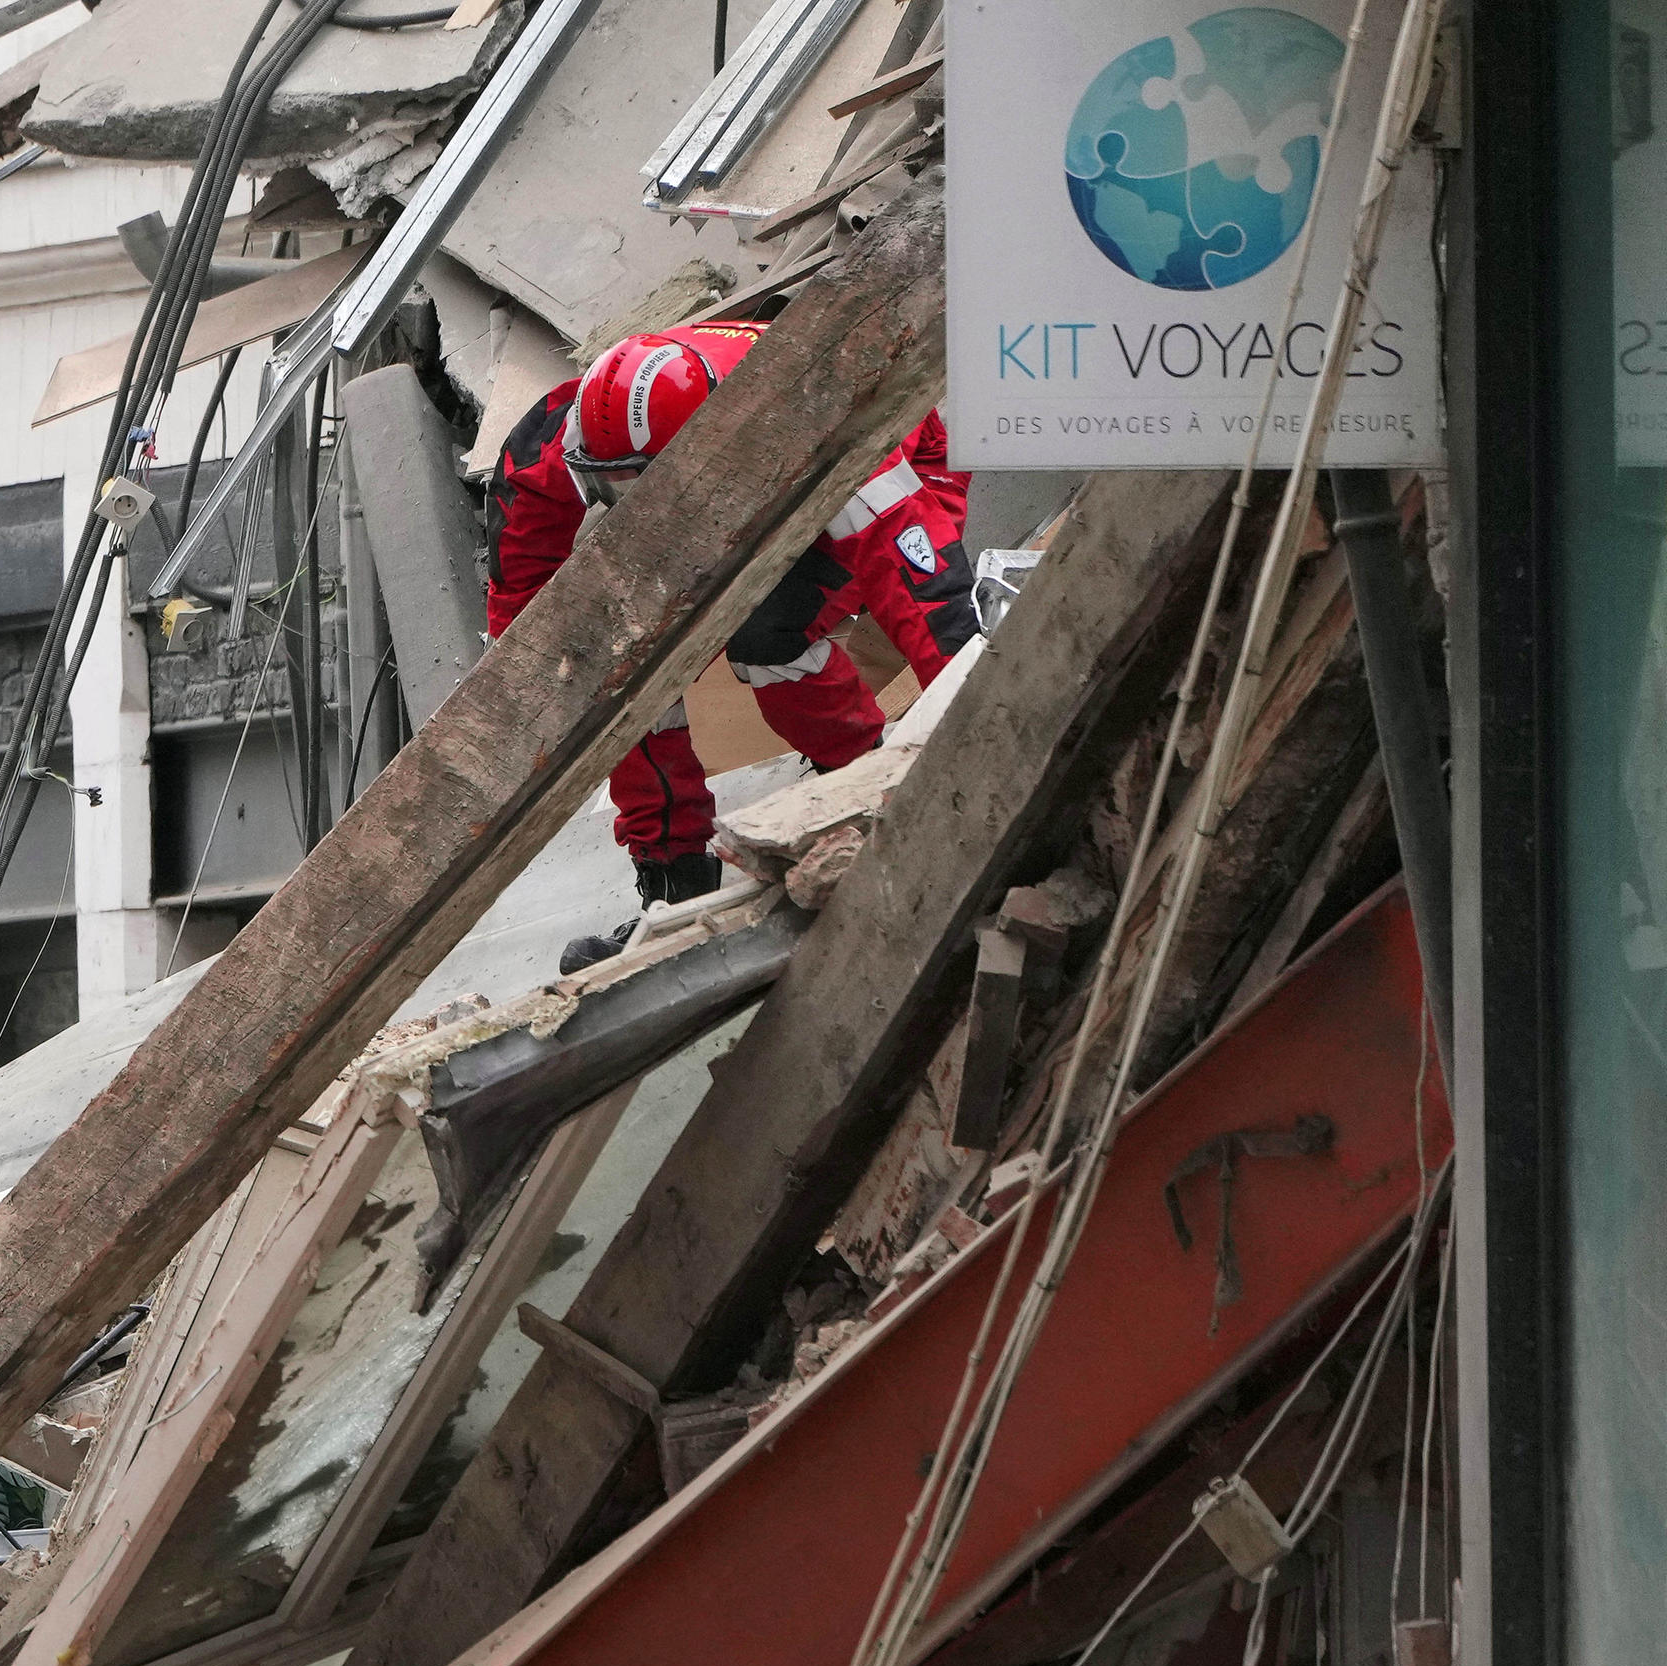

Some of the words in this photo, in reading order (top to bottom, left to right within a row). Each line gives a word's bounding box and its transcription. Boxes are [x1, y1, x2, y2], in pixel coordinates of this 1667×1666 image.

[639, 349, 671, 382] POMPIERS
[998, 322, 1097, 380] KIT
[633, 384, 646, 429] SAPEURS
[996, 415, 1043, 435] DES
[1061, 415, 1171, 435] VOYAGES
[1186, 408, 1203, 434] À
